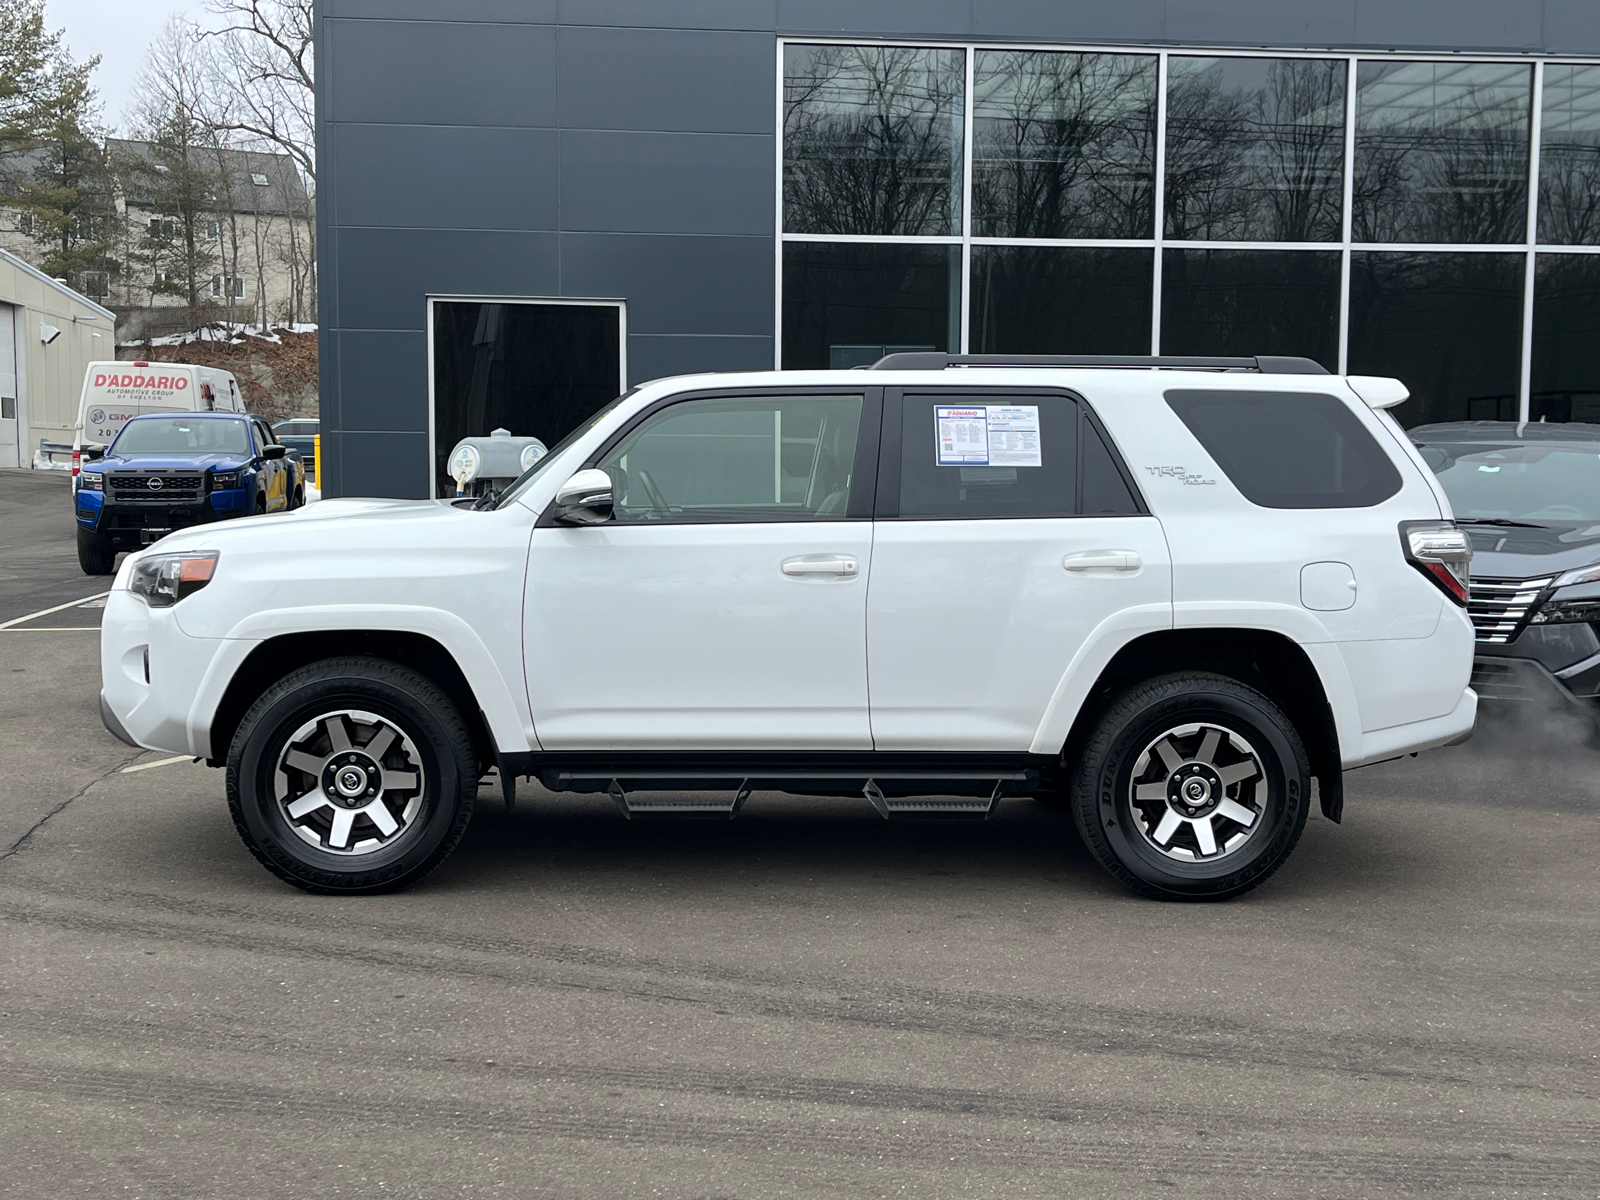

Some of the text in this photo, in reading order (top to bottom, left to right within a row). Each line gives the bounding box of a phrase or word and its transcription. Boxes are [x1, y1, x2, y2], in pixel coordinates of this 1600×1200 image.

[94, 374, 188, 390] D'ADDARIO
[109, 413, 133, 421] GM
[1145, 466, 1186, 477] TRD
